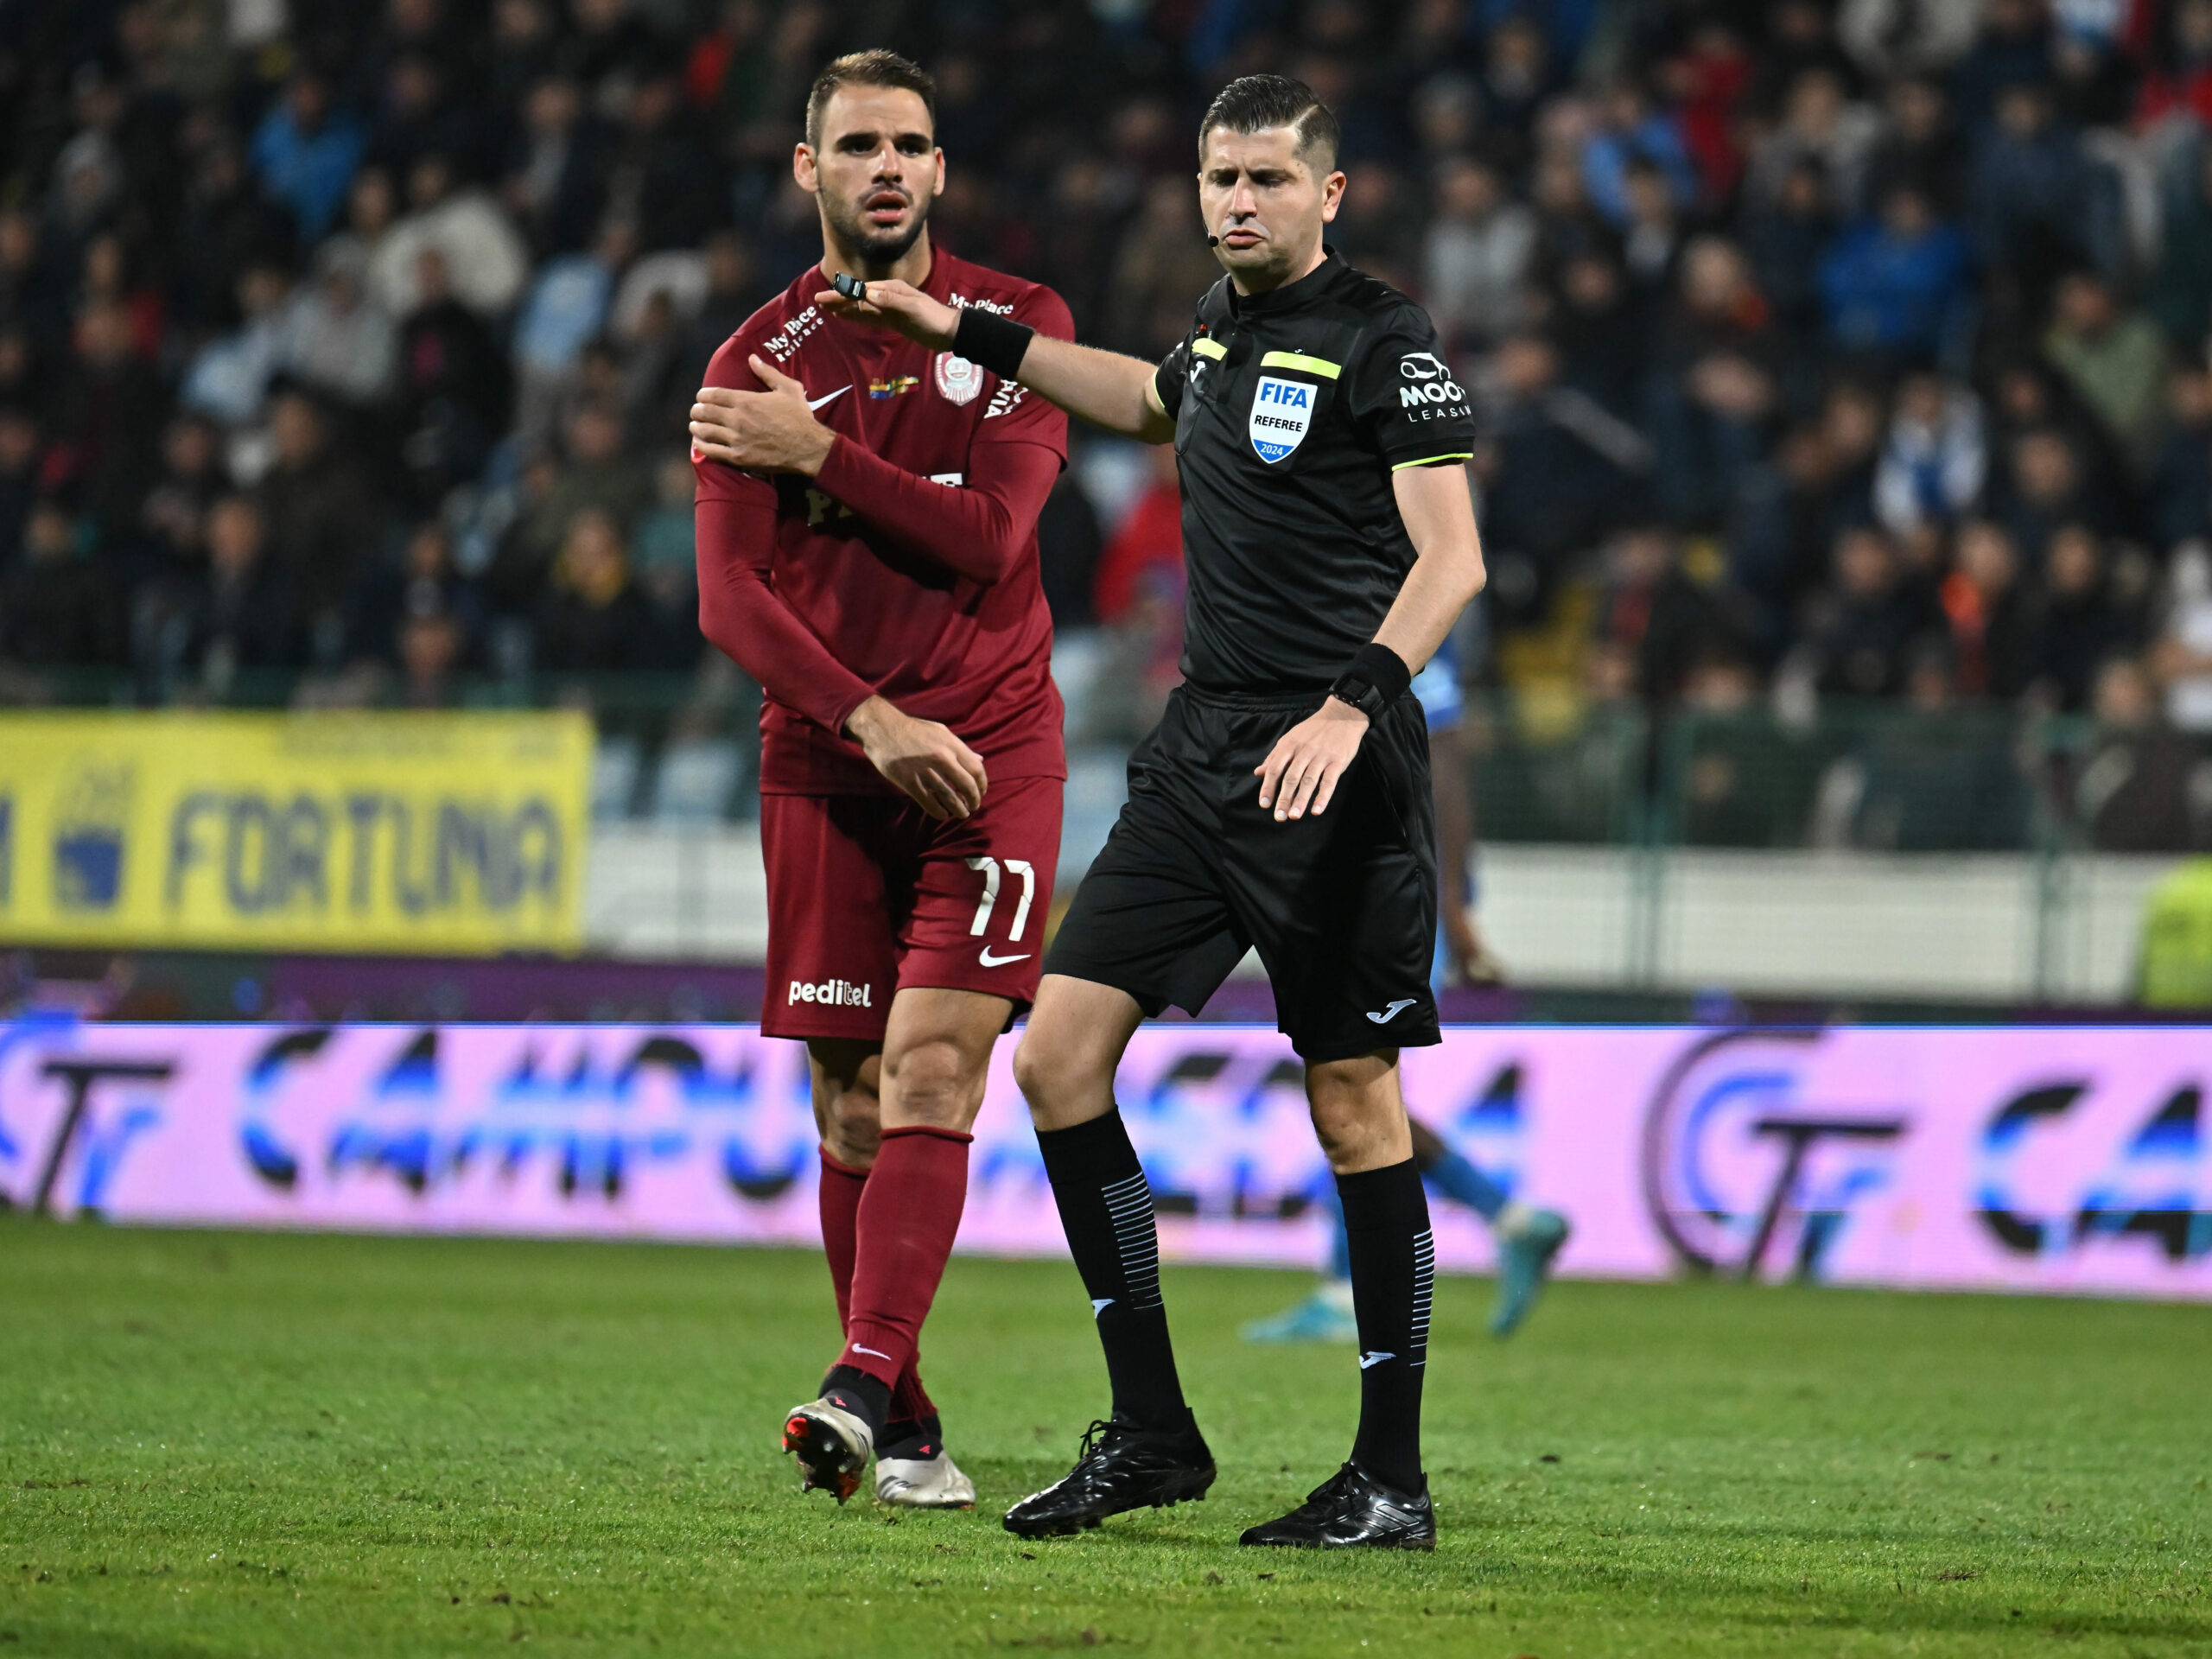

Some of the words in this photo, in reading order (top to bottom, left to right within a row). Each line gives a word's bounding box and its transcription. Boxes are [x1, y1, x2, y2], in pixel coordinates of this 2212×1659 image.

[763, 333, 788, 353] My
[1261, 382, 1307, 409] FIFA
[1399, 380, 1466, 408] MOO
[1255, 415, 1303, 432] REFEREE
[1261, 443, 1284, 455] 2024
[965, 856, 1035, 941] 77
[787, 978, 872, 1008] peditel
